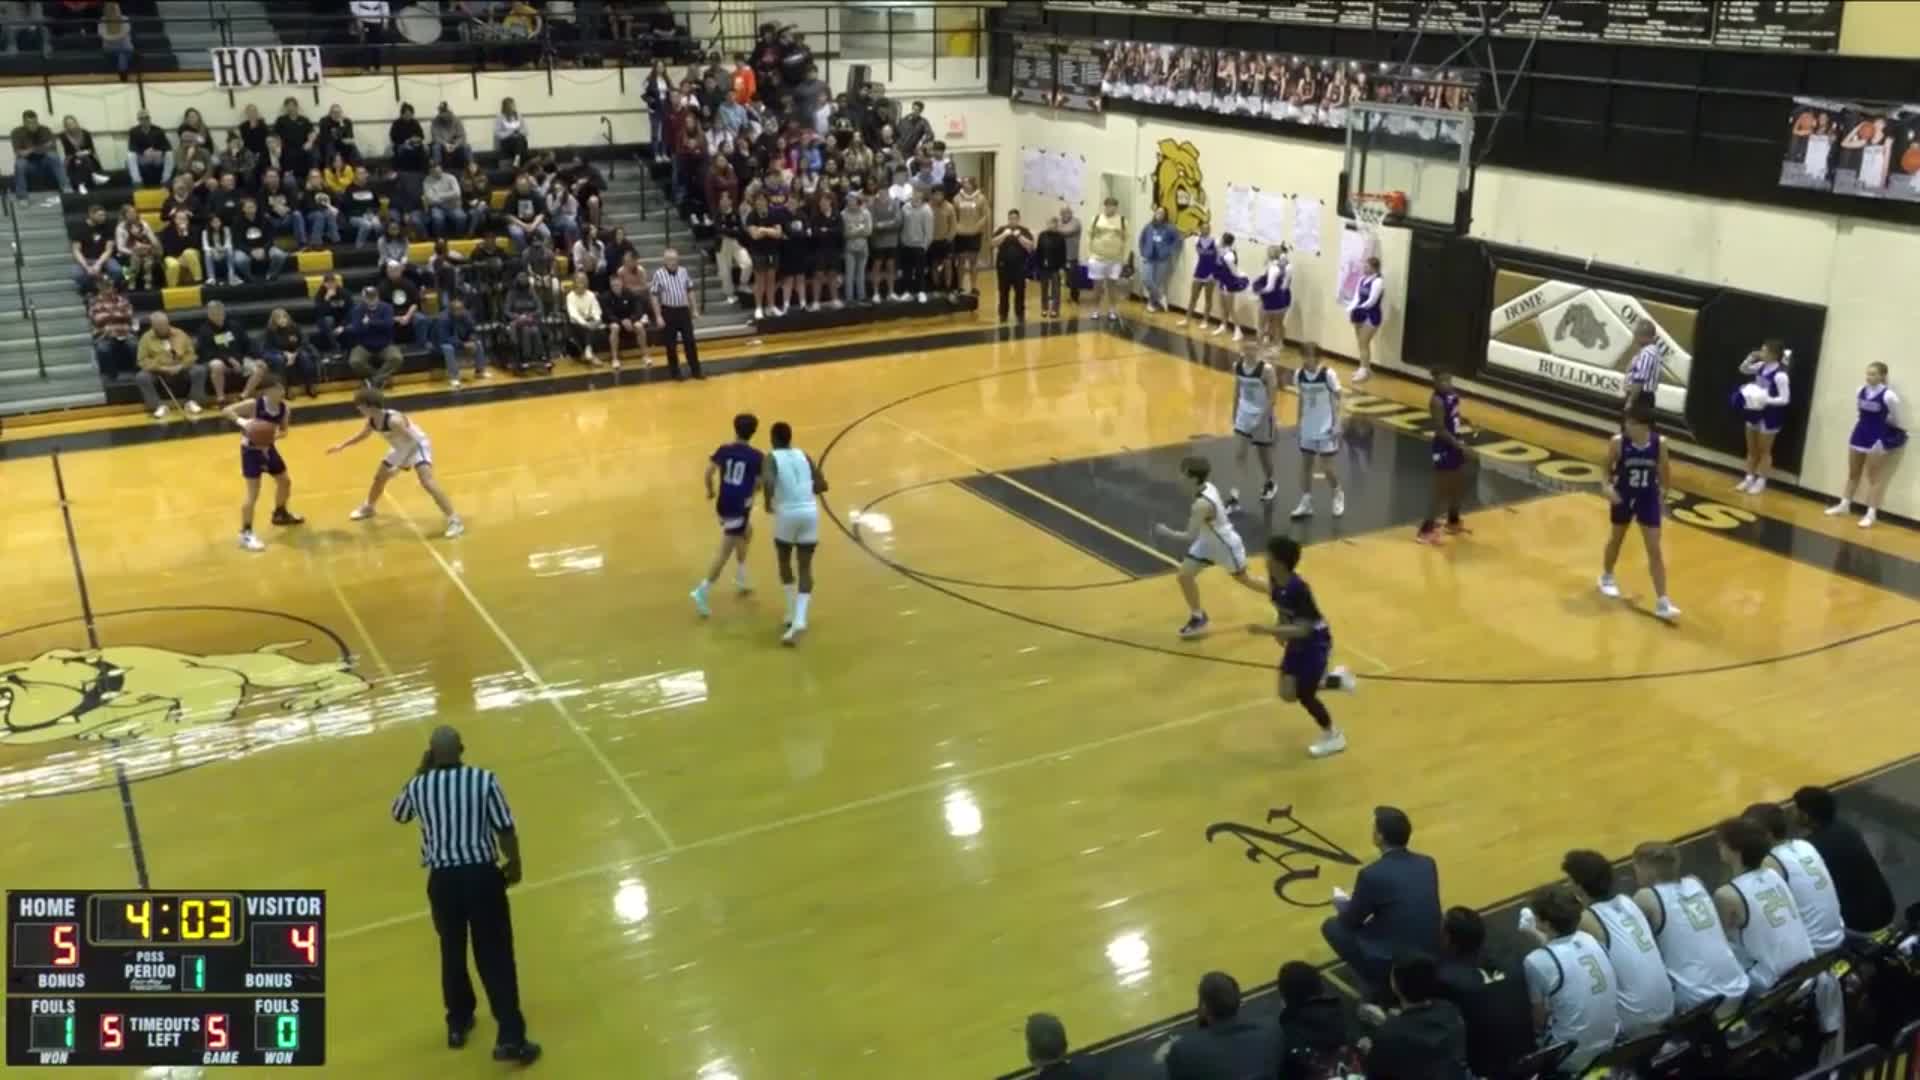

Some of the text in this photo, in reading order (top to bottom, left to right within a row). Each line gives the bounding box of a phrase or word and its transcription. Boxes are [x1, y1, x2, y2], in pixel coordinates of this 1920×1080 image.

[213, 47, 320, 87] HOME
[1504, 291, 1546, 321] HOME
[1537, 359, 1621, 392] BULLDOGS
[723, 458, 747, 486] 10
[1628, 468, 1649, 488] 21
[1578, 954, 1608, 996] 3
